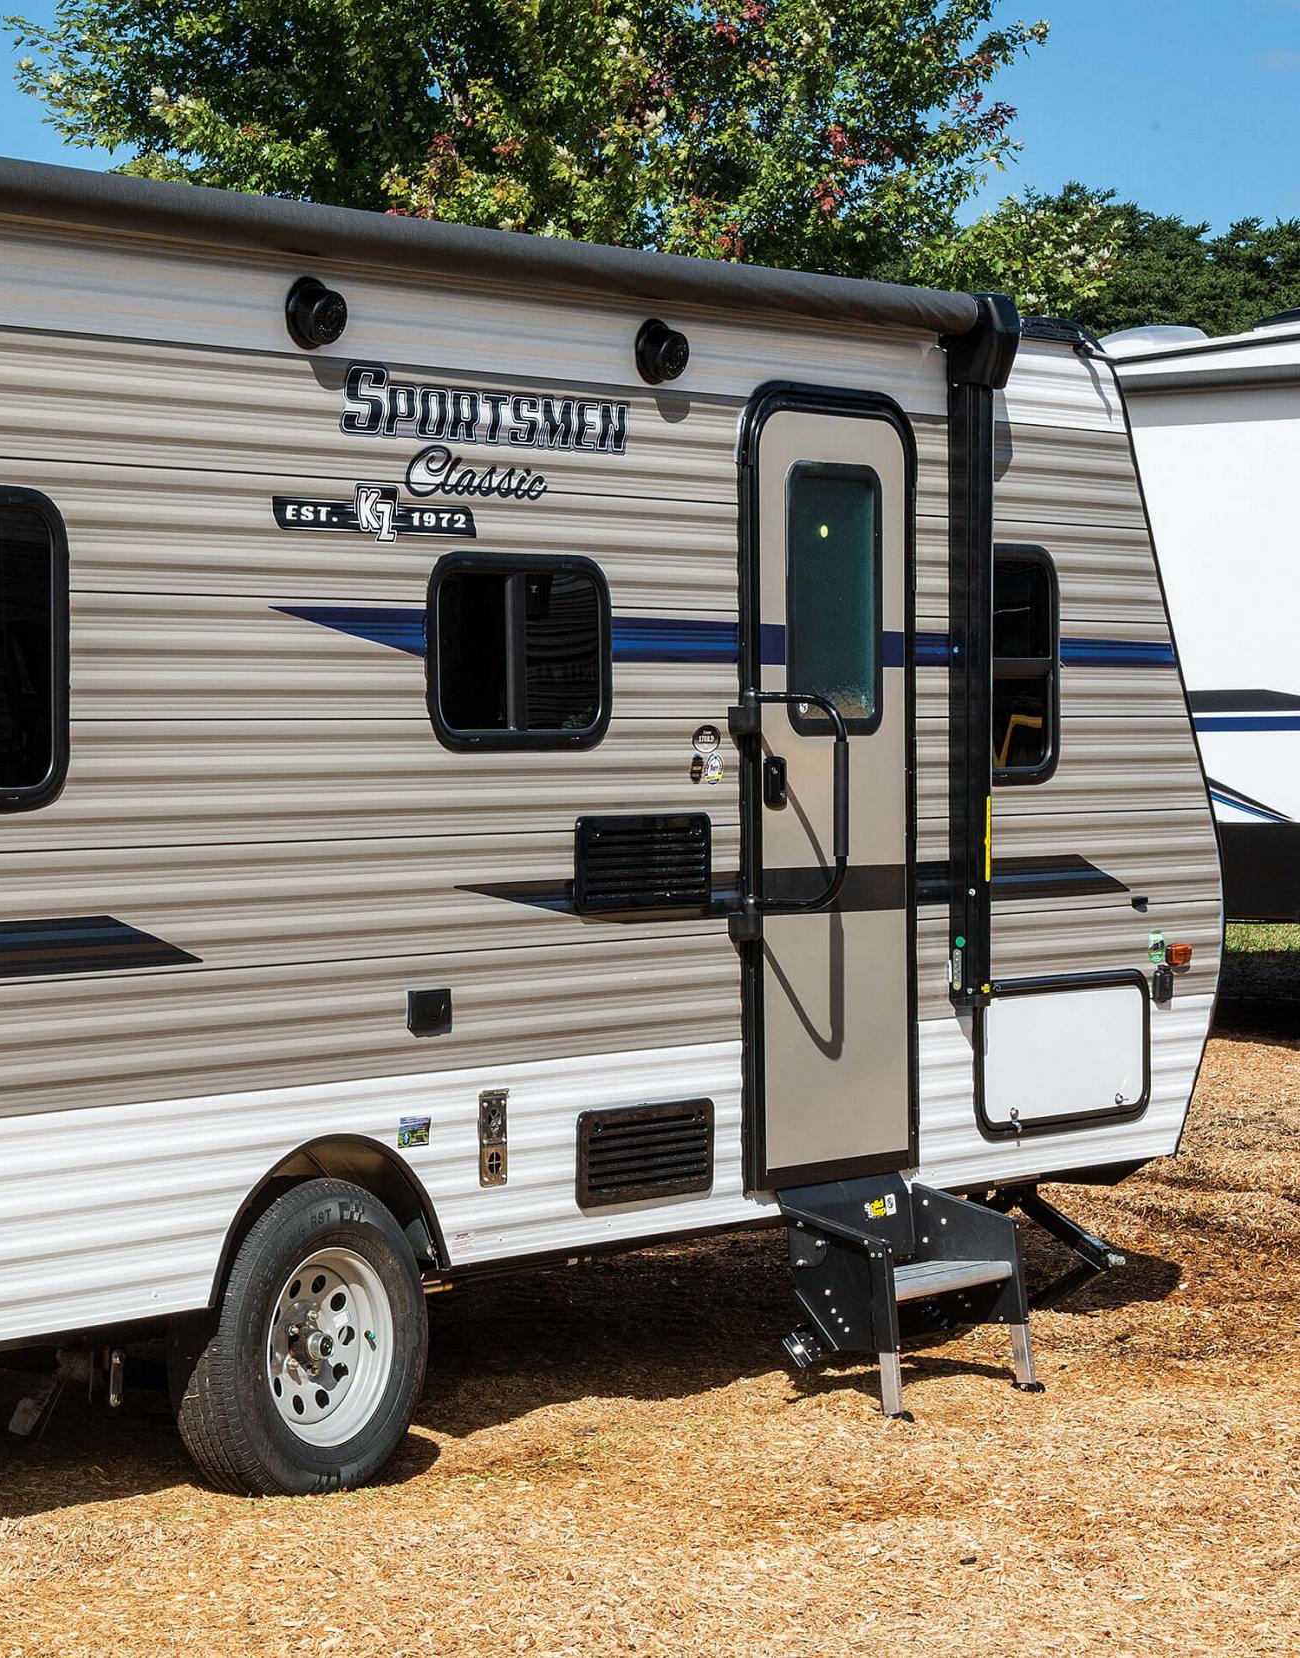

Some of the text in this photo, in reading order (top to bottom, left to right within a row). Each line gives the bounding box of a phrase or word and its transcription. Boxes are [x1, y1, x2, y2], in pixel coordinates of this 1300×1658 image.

[339, 362, 630, 455] SPORTSMEN
[405, 444, 548, 501] Classic
[285, 488, 467, 543] EST. KZ 1972
[309, 1207, 332, 1230] RST
